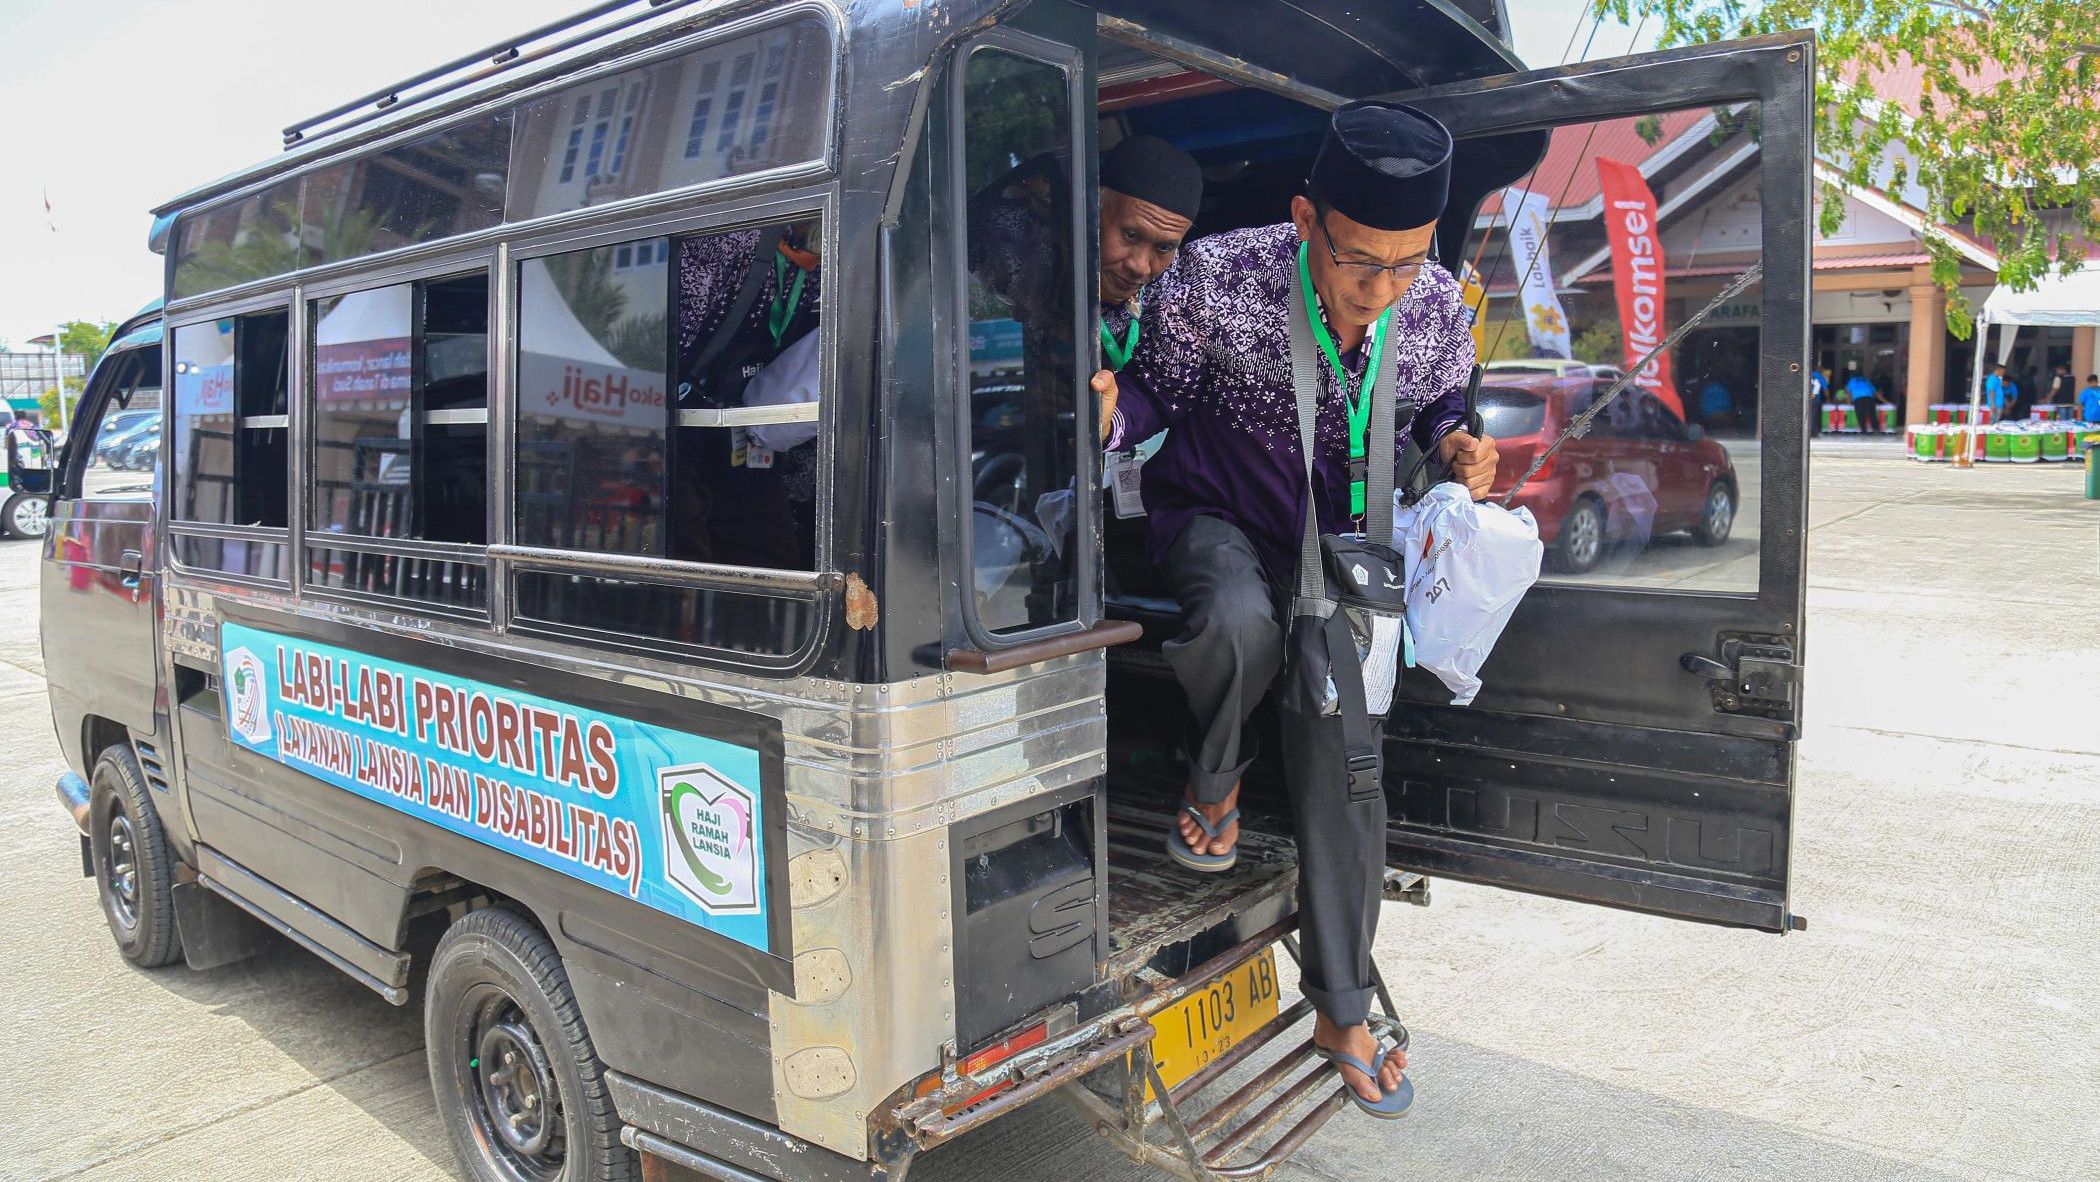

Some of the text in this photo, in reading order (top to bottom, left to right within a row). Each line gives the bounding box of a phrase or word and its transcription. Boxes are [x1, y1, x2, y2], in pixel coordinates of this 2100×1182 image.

[1519, 227, 1545, 288] Labbaik
[1614, 200, 1663, 388] Telkomsel
[1434, 537, 1453, 562] onesia
[1425, 577, 1451, 605] 207
[276, 646, 617, 796] LABI-LABI PRIORITAS
[275, 712, 641, 895] (LAYANAN LANSIA DAN DISABILITAS)
[696, 808, 721, 827] HAJI
[691, 821, 729, 844] RAMAH
[692, 836, 732, 860] LANSIA
[1183, 957, 1273, 1049] 1103 AB
